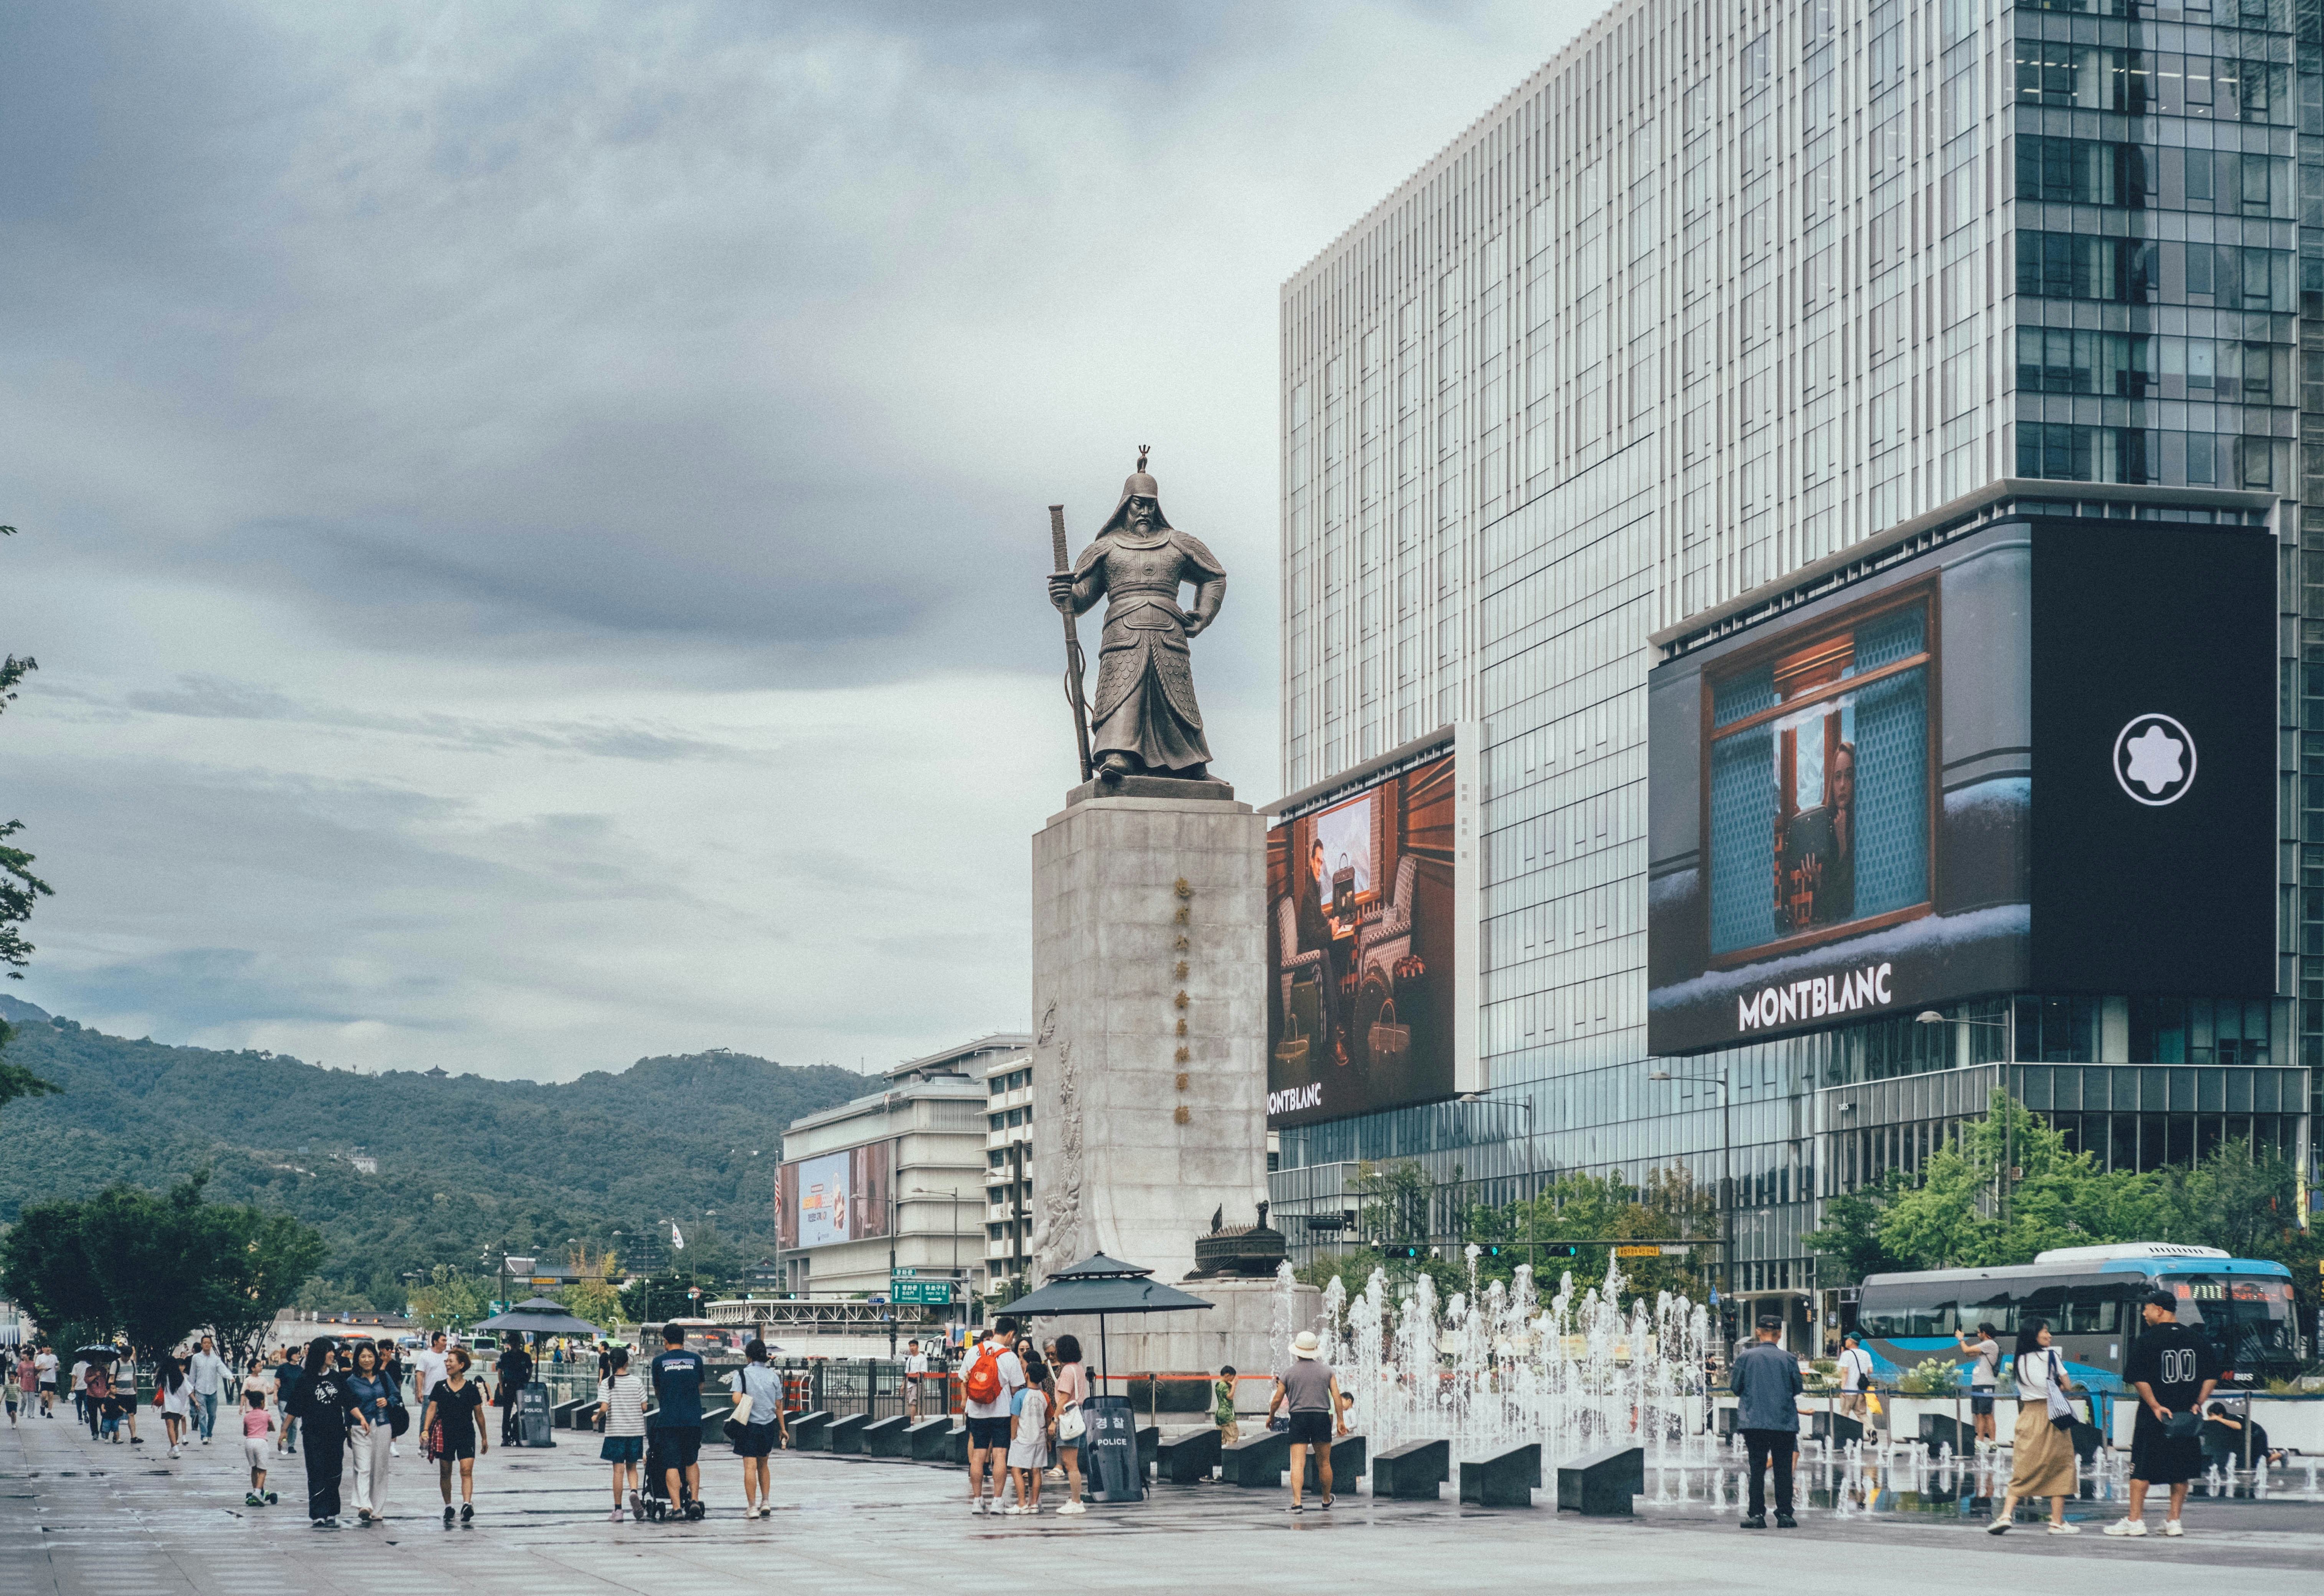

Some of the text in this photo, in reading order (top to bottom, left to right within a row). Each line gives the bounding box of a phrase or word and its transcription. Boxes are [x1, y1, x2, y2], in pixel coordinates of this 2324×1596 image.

[1739, 962, 1891, 1032] MONTBLANC
[1267, 1082, 1321, 1115] ONTBLANC
[664, 1364, 694, 1372] patagonia
[2161, 1349, 2196, 1384] 00
[524, 1395, 542, 1403] 경찰
[1095, 1417, 1125, 1429] 경찰
[1097, 1438, 1127, 1446] POLICE
